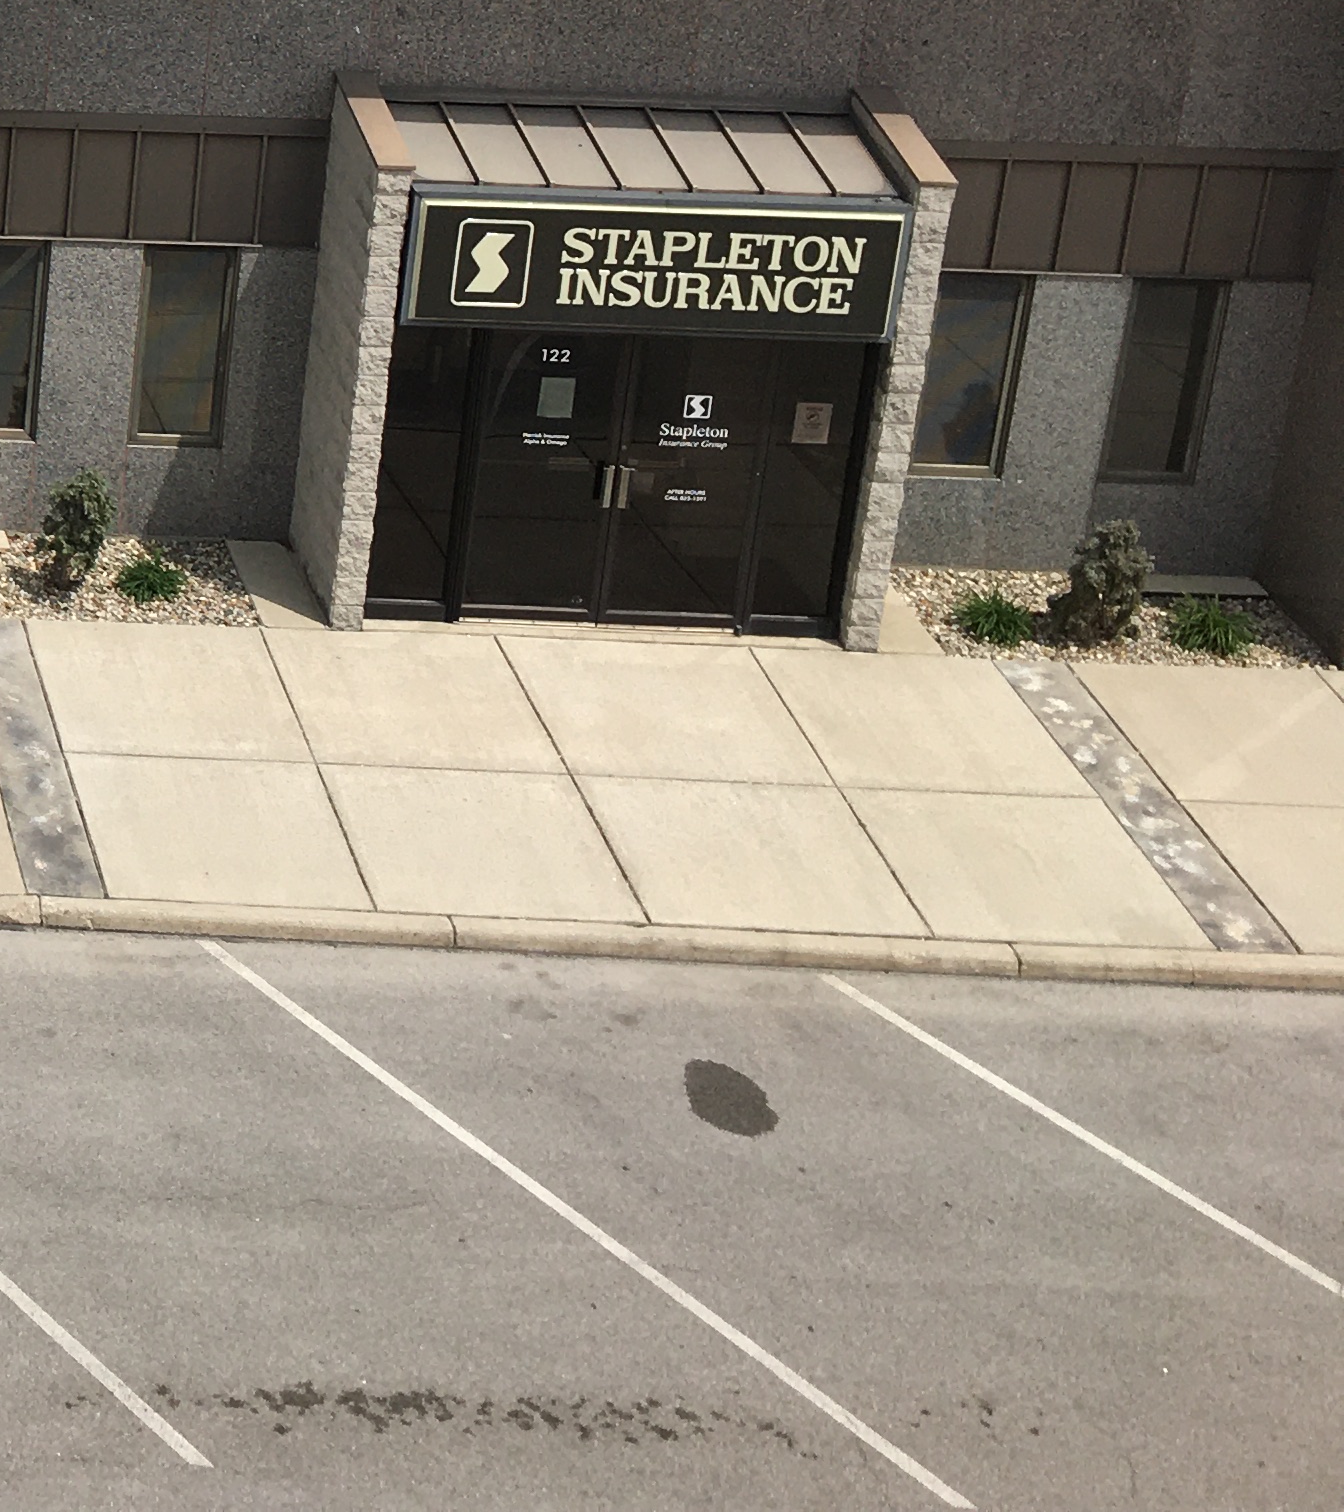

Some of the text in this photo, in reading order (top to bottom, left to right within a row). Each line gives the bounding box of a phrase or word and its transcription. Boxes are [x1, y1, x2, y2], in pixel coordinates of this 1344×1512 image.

[561, 228, 867, 274] STAPLETON
[556, 268, 854, 315] INSURANCE
[541, 348, 571, 363] 122
[659, 423, 729, 439] Stapleton
[658, 438, 728, 450] Insurance Group
